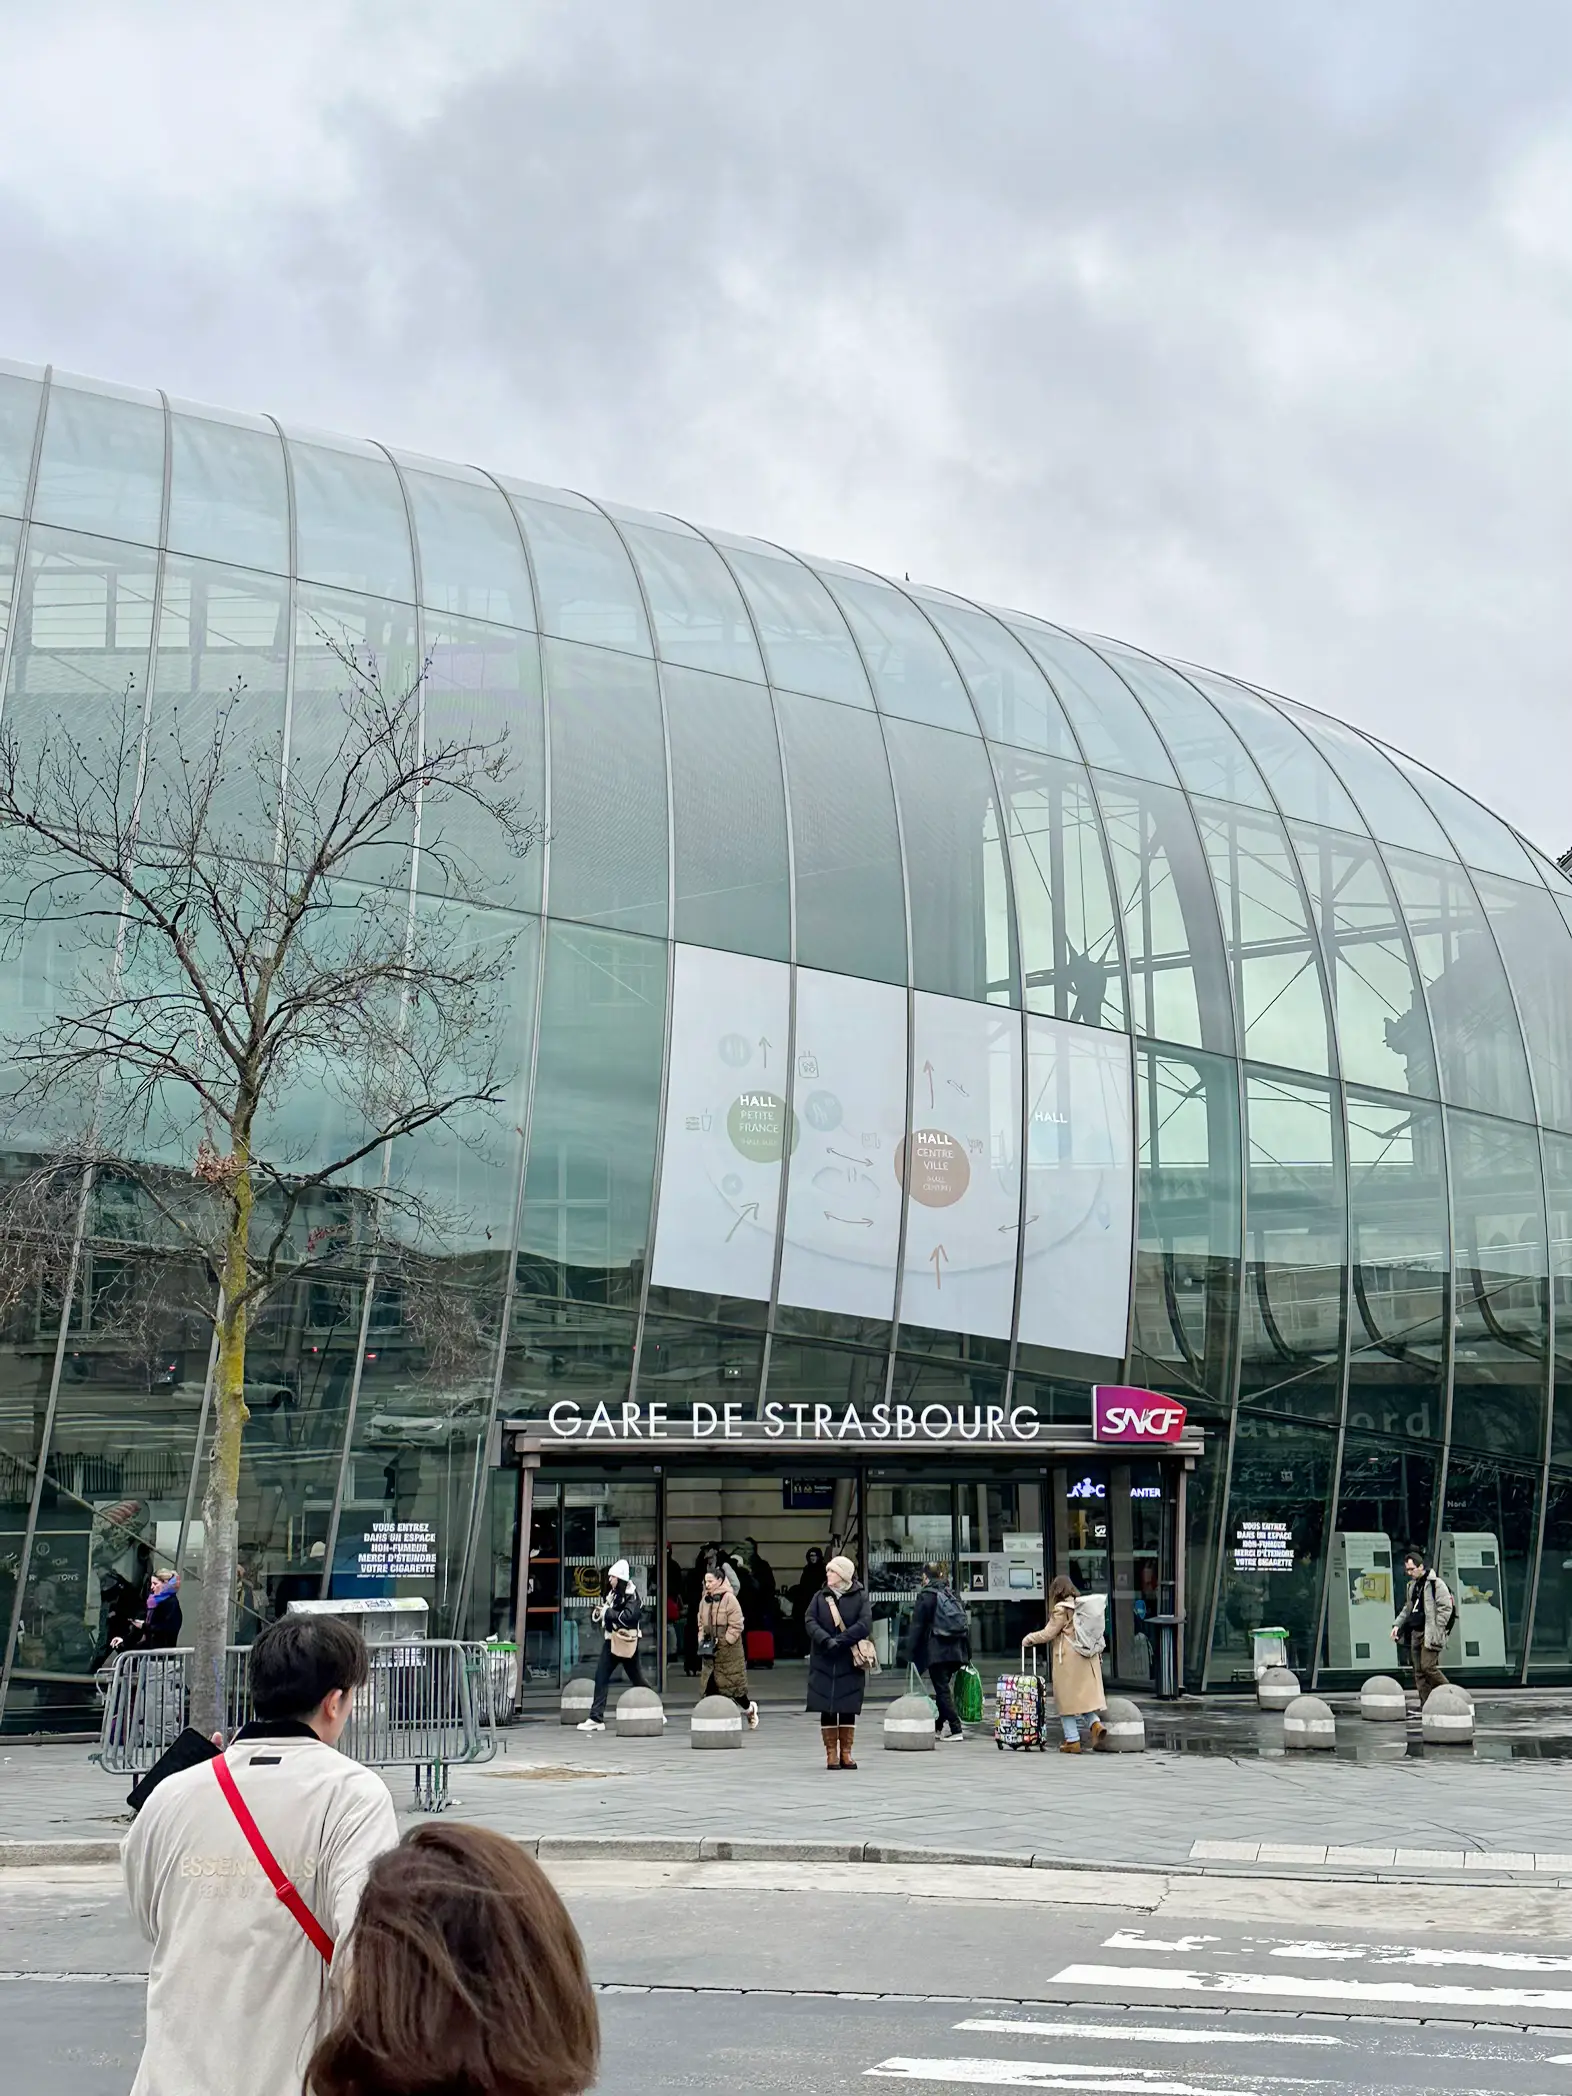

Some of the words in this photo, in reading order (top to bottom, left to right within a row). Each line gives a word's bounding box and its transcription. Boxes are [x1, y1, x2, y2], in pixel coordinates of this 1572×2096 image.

[740, 1095, 776, 1108] HALL
[1035, 1111, 1068, 1124] HALL
[917, 1133, 953, 1146] HALL
[917, 1148, 954, 1159] CENTRE
[923, 1161, 949, 1171] VILLE
[548, 1400, 668, 1437] GARE
[693, 1402, 743, 1437] DE
[764, 1402, 1040, 1439] STRASBOURG
[1101, 1407, 1184, 1435] SNCF
[373, 1523, 395, 1532] VOUS
[397, 1523, 429, 1532] ENTREZ
[363, 1533, 388, 1543] DANS
[403, 1533, 436, 1543] ESPACE
[371, 1543, 428, 1553] NON-FUMEUR
[358, 1553, 386, 1563] MERCI
[361, 1564, 389, 1573] VOTRE
[390, 1564, 436, 1573] CIGARETTE
